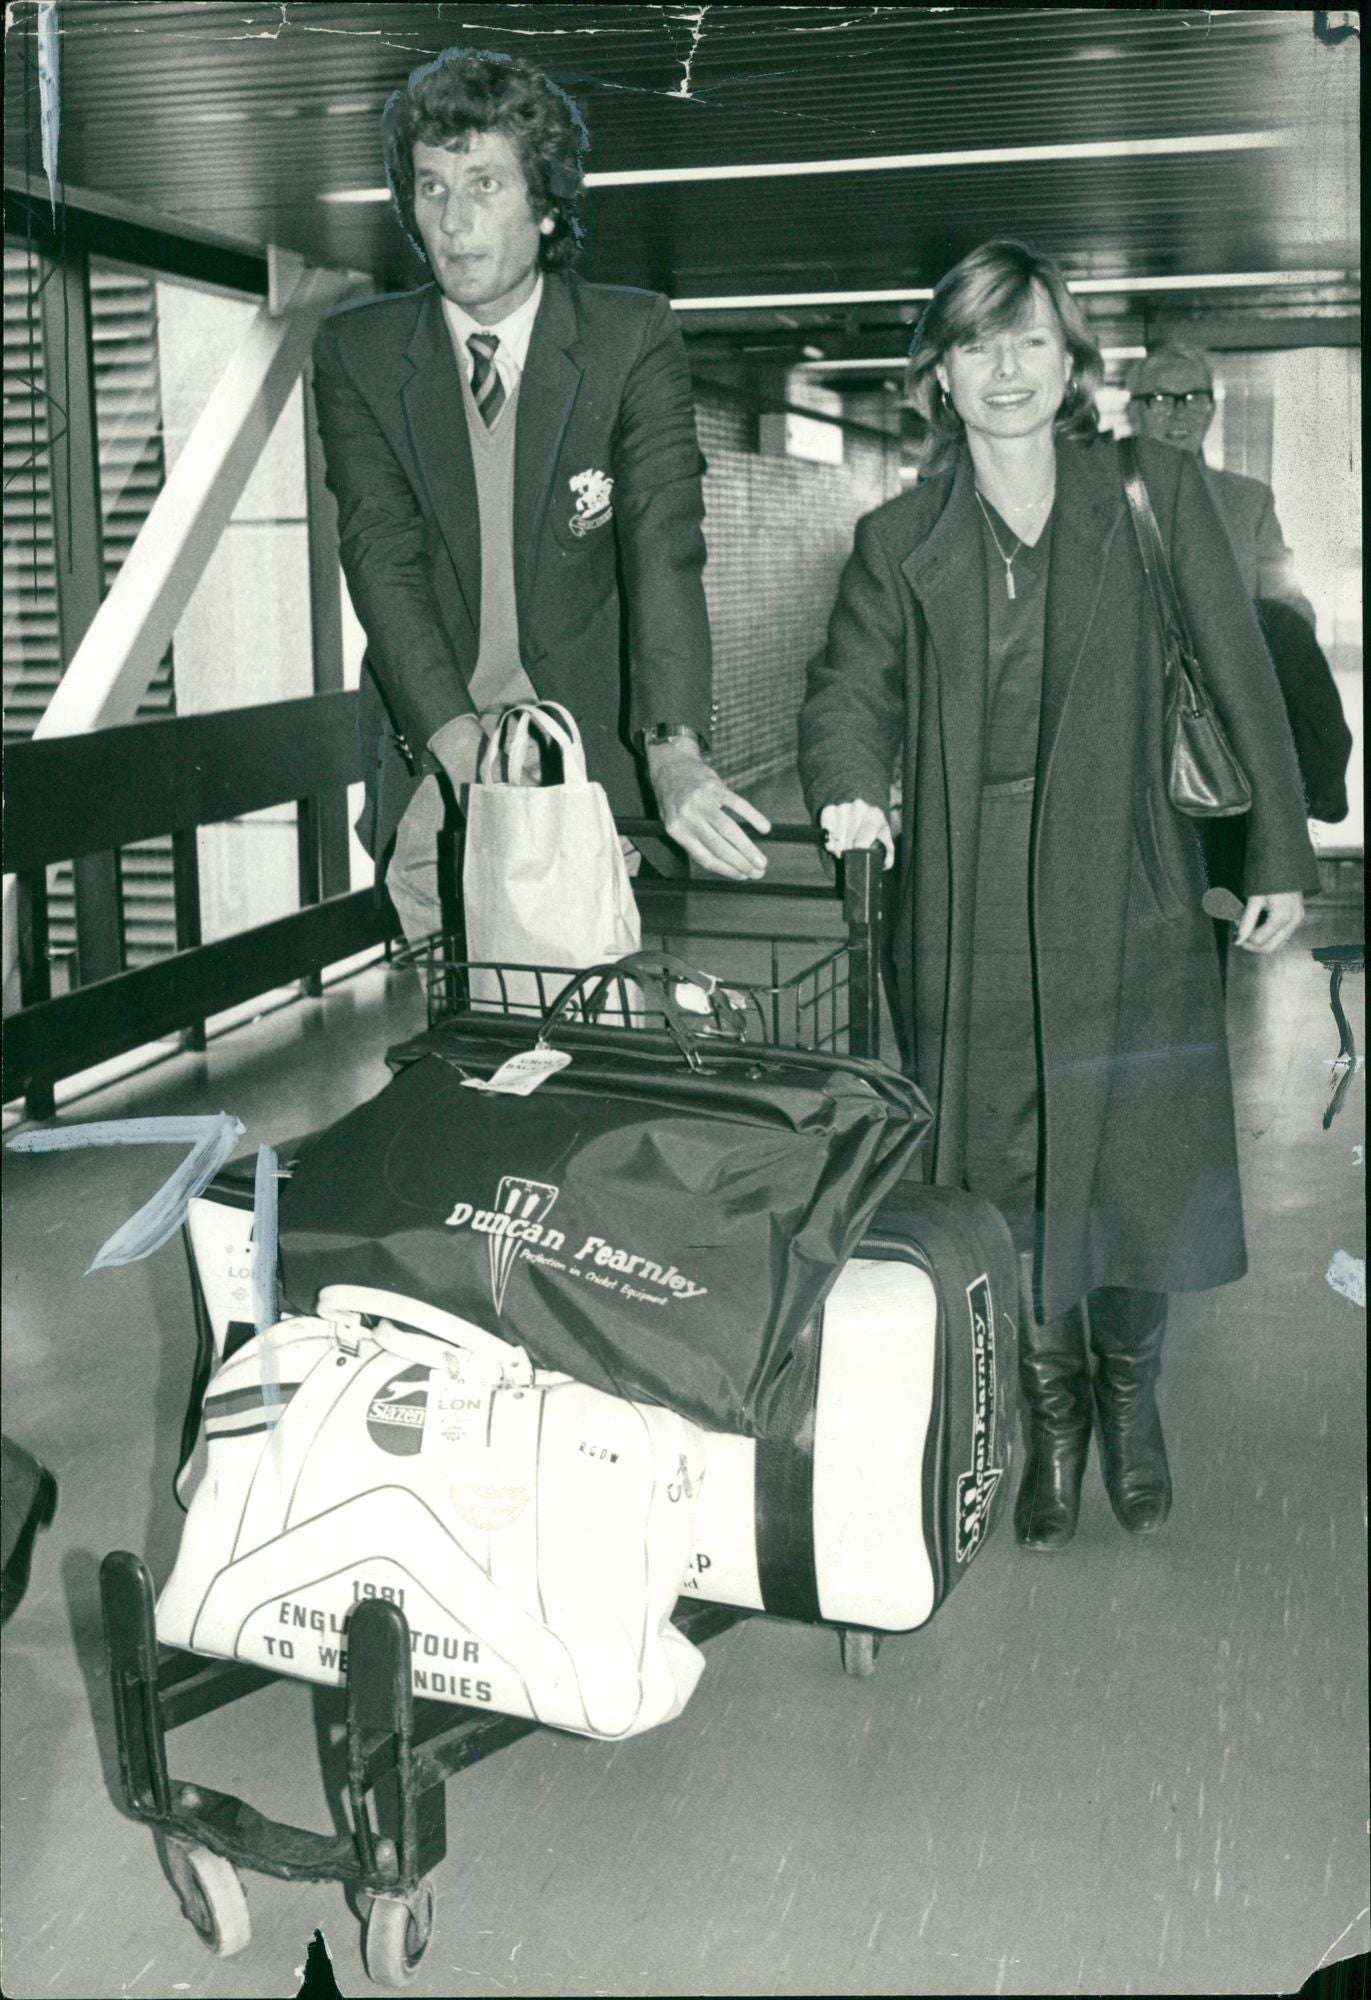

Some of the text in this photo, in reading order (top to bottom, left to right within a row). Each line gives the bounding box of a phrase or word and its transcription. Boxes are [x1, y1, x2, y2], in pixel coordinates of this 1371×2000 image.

[445, 1203, 708, 1298] Duncan Fearnley
[228, 1266, 257, 1279] LO
[569, 1265, 581, 1276] in
[585, 1271, 618, 1290] Cricket
[620, 1284, 668, 1305] Equipment
[369, 1402, 425, 1425] Slazen
[438, 1399, 481, 1411] LON
[972, 1312, 986, 1542] Duncan Fearnley
[352, 1580, 406, 1611] 1981
[279, 1602, 480, 1663] ENGL TOUR
[263, 1635, 492, 1702] TO WE NDIES
